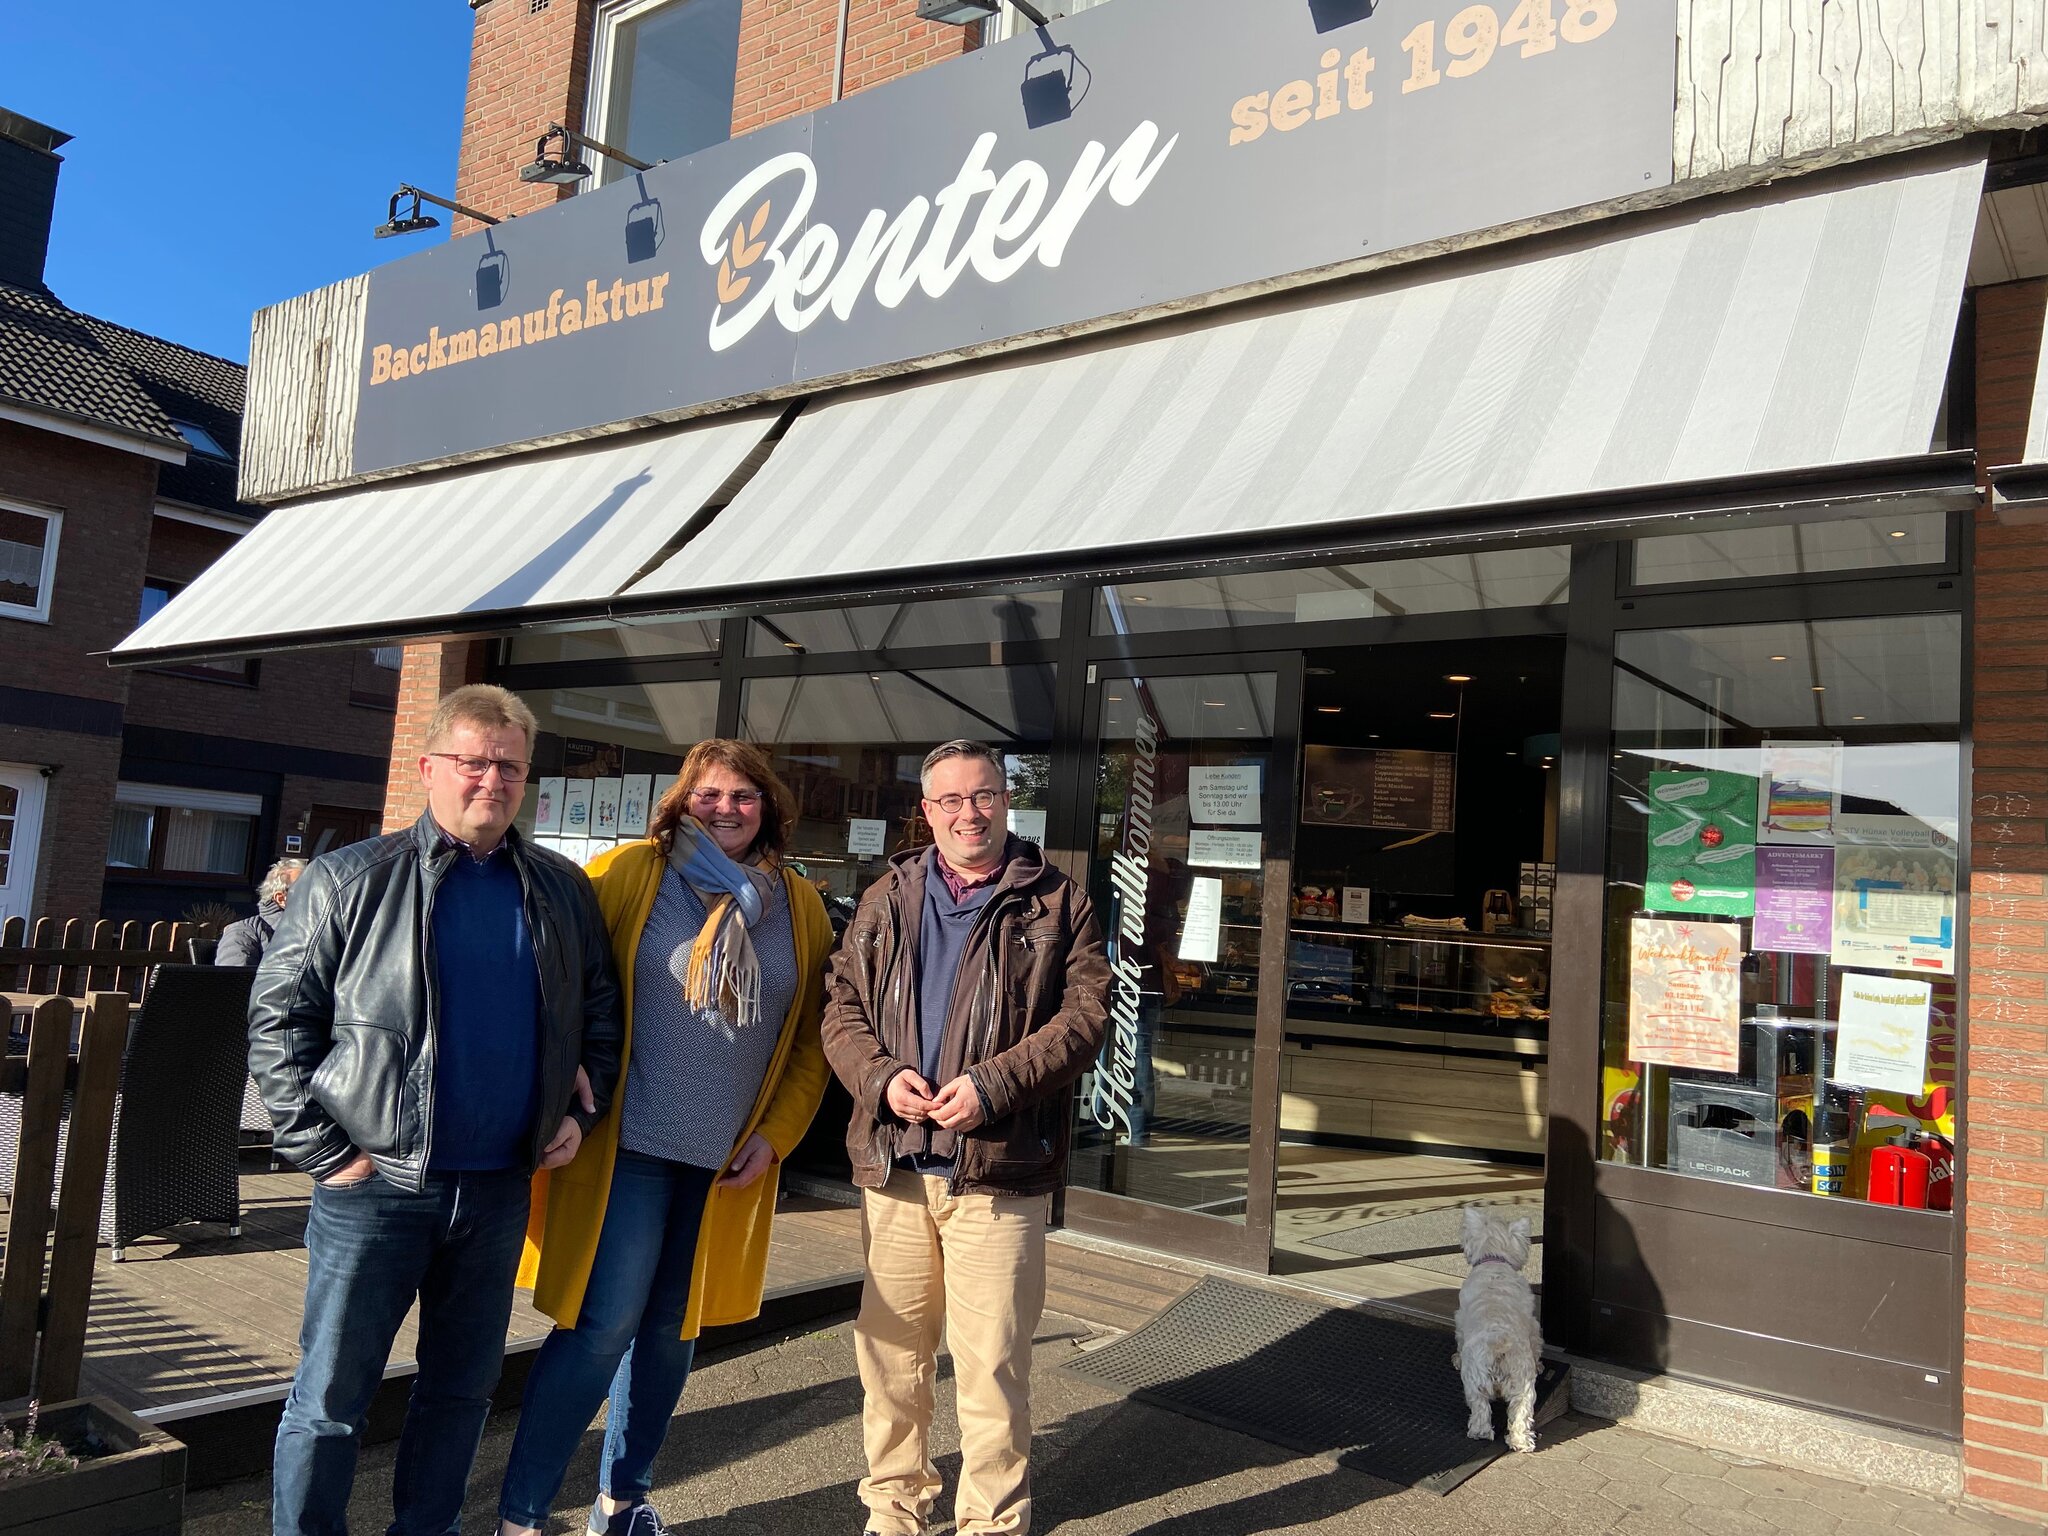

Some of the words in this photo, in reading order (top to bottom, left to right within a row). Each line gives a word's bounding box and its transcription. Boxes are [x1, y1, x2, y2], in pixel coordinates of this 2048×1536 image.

[1229, 46, 1375, 146] seit
[1401, 0, 1618, 95] 1948
[699, 119, 1180, 352] Benter
[370, 271, 671, 387] Backmanufaktur
[1198, 792, 1223, 800] Sonntag
[1209, 784, 1235, 792] Samstag
[1111, 713, 1159, 947] willkommen
[1767, 851, 1825, 859] ADVENTSMARKT
[1890, 828, 1930, 838] Volleyball
[1092, 954, 1153, 1146] Herzlich
[1689, 1161, 1751, 1179] LEGIPACK
